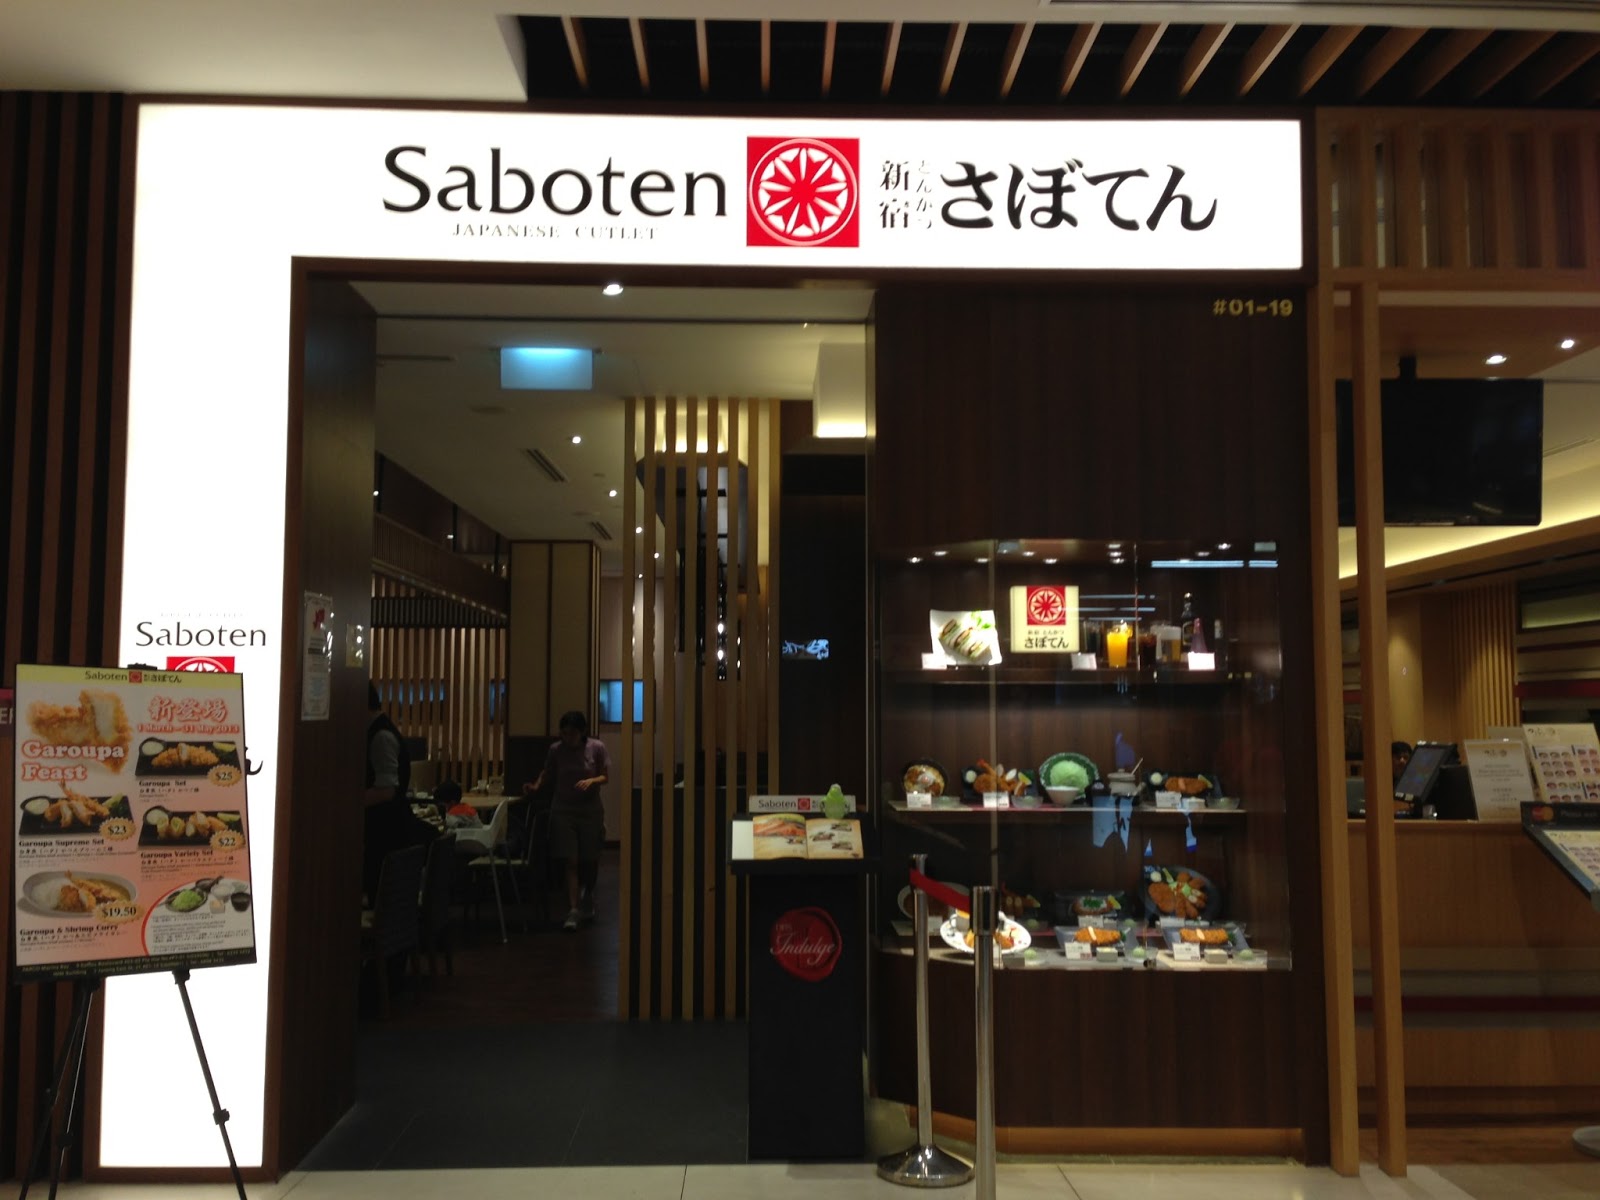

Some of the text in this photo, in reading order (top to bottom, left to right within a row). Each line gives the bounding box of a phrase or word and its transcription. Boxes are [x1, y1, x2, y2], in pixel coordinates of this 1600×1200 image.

[383, 145, 727, 217] Saboten
[940, 158, 1218, 231] さぼてん
[453, 223, 657, 239] JAPANESE CUTLET
[1212, 298, 1294, 317] #01-19
[135, 621, 267, 647] Saboten
[1024, 636, 1070, 649] さぼてん
[85, 670, 128, 682] Saboten
[149, 694, 229, 723] 新登場
[146, 723, 173, 733] March
[22, 740, 124, 761] Garoupa
[22, 763, 87, 782] Feast
[215, 771, 233, 781] $25
[139, 780, 170, 788] Garoupa
[758, 799, 797, 809] Saboten
[108, 825, 127, 835] $23
[19, 840, 53, 848] Garoupa
[55, 839, 90, 847] Supreme
[218, 837, 236, 847] $22
[140, 851, 173, 860] Garoupa
[174, 850, 199, 858] Variety
[102, 906, 137, 918] $19.50
[20, 928, 54, 937] Garoupa
[65, 925, 94, 935] Shrimp
[96, 924, 119, 933] Curry
[769, 931, 836, 966] Indulge
